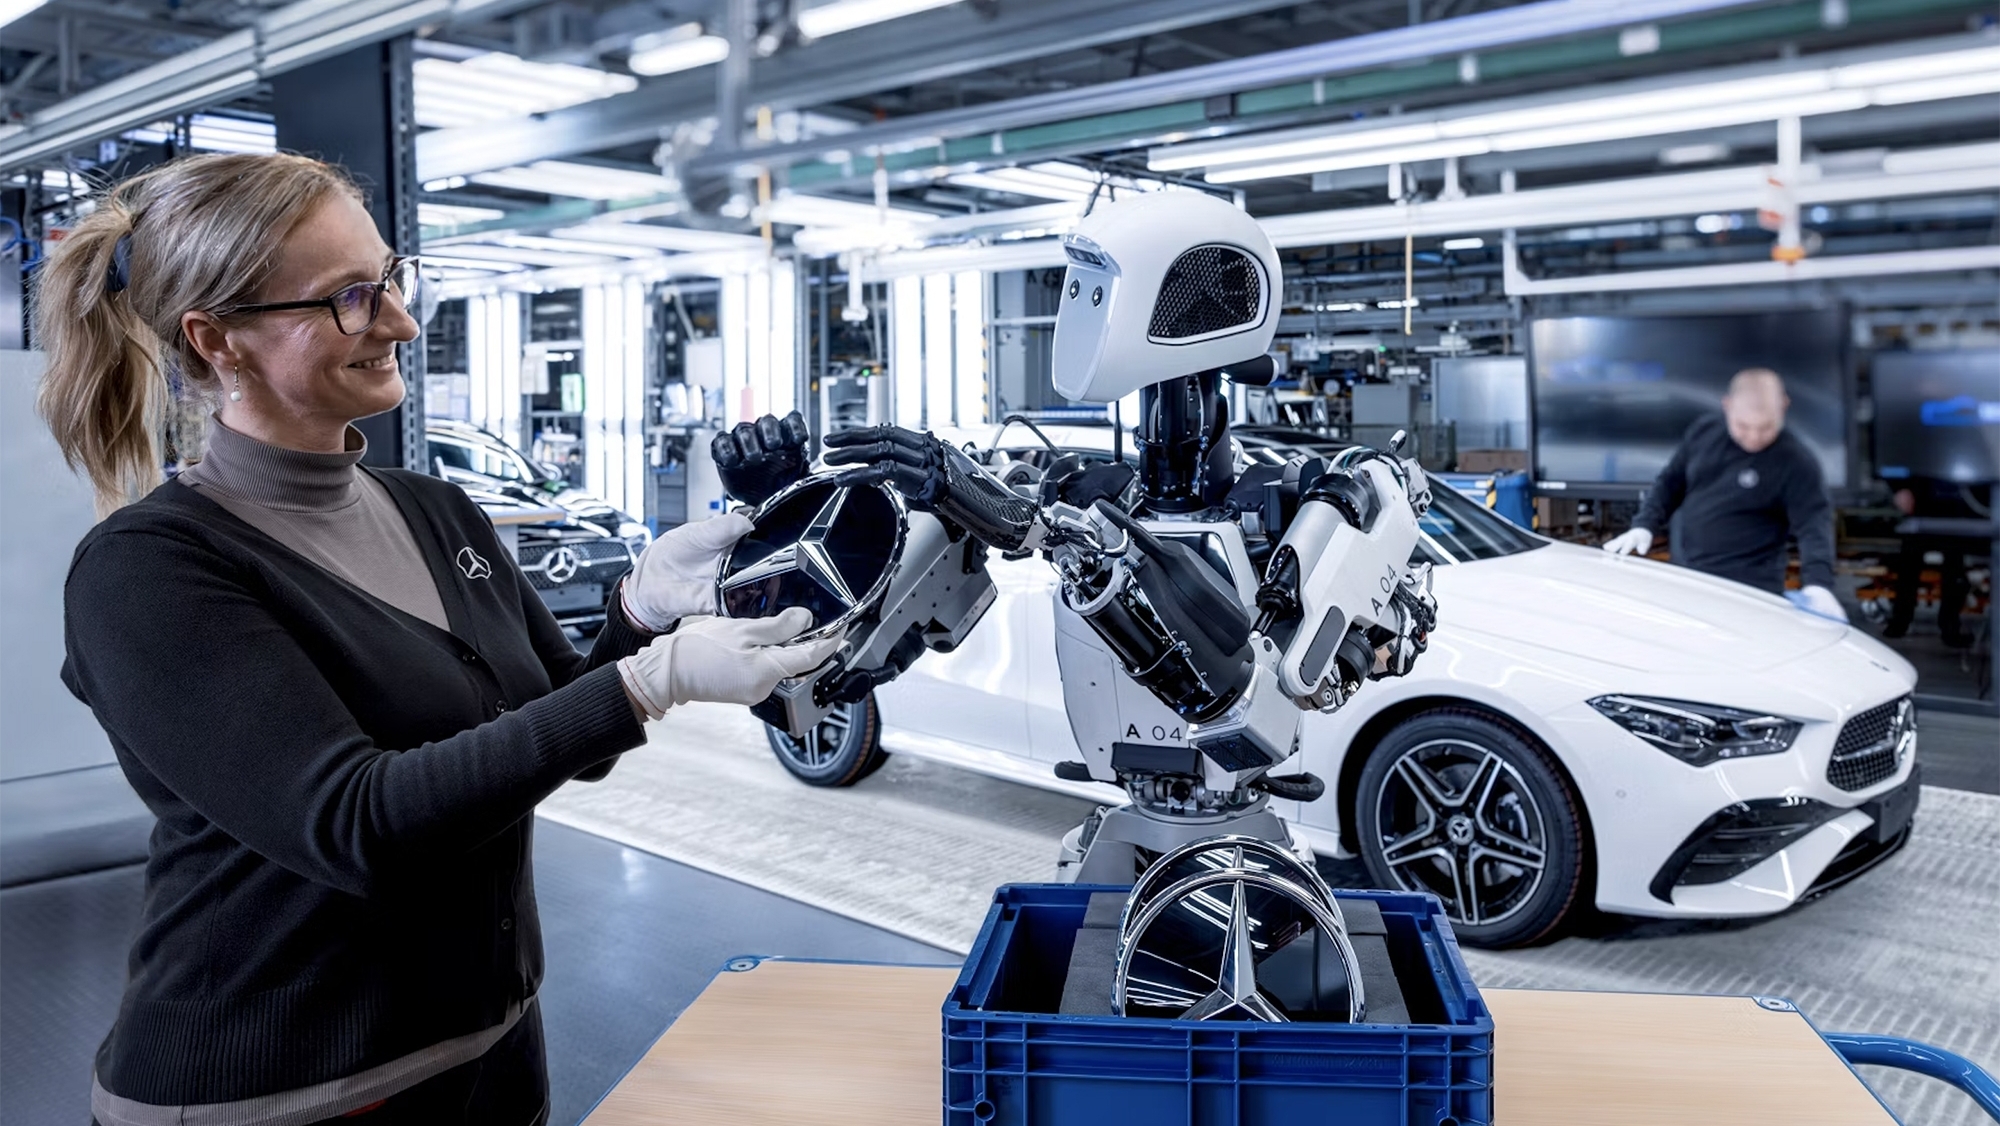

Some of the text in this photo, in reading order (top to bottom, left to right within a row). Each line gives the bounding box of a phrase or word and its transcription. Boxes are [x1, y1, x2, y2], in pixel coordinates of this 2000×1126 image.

[1371, 563, 1397, 617] A 04
[1126, 723, 1182, 742] A 04
